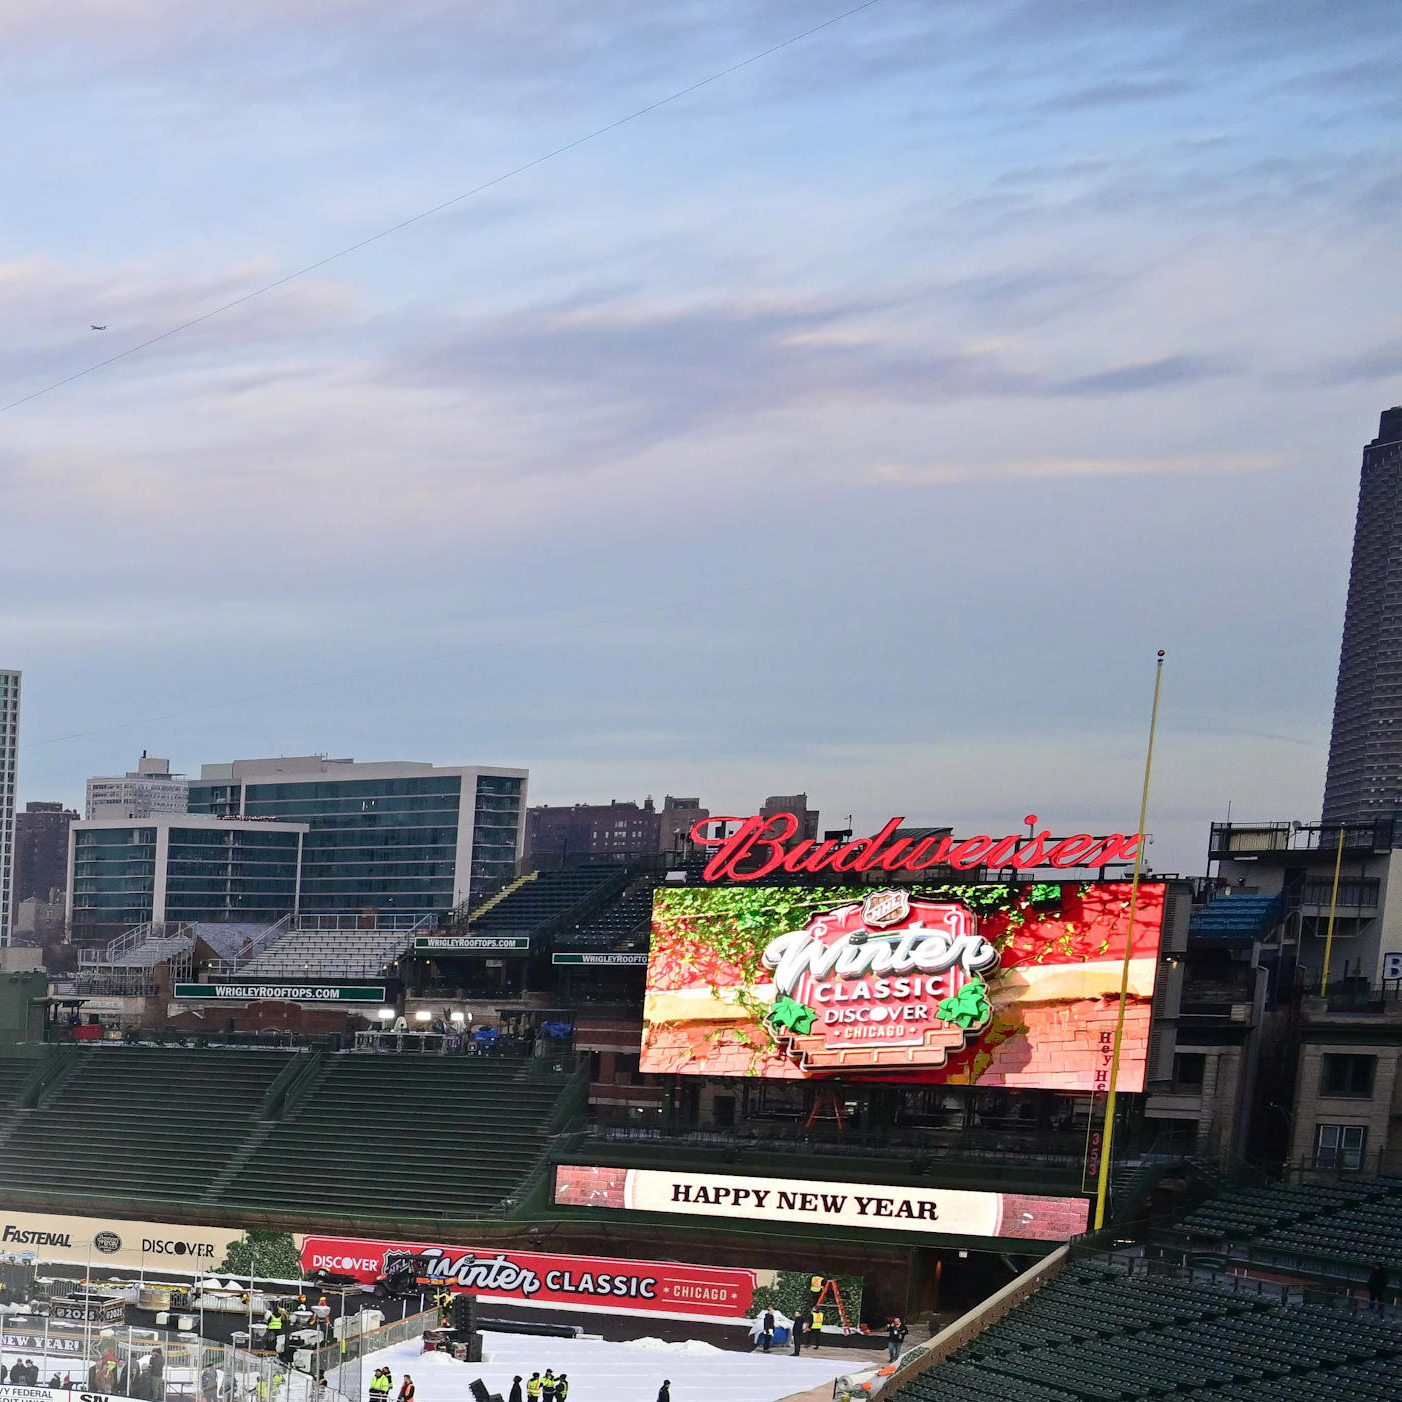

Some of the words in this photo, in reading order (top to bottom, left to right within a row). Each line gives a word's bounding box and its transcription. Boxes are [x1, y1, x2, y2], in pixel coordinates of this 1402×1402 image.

[691, 812, 1145, 882] Budweiser
[763, 921, 996, 994] Winter
[815, 975, 945, 1002] CLASSIC
[824, 1005, 928, 1024] DISCOVER
[844, 1025, 904, 1038] CHICAGO
[671, 1184, 770, 1209] HAPPY
[776, 1191, 847, 1214] NEW
[854, 1196, 940, 1221] YEAR
[2, 1225, 71, 1248] FASTENAL
[142, 1239, 215, 1258] DISCOVER
[313, 1254, 378, 1272] DISCOVER
[546, 1269, 656, 1299] CLASSIC
[673, 1285, 727, 1301] CHICAGO
[65, 1309, 95, 1320] 2025
[34, 1337, 79, 1351] YEAR!
[12, 1387, 53, 1399] FEDERAL
